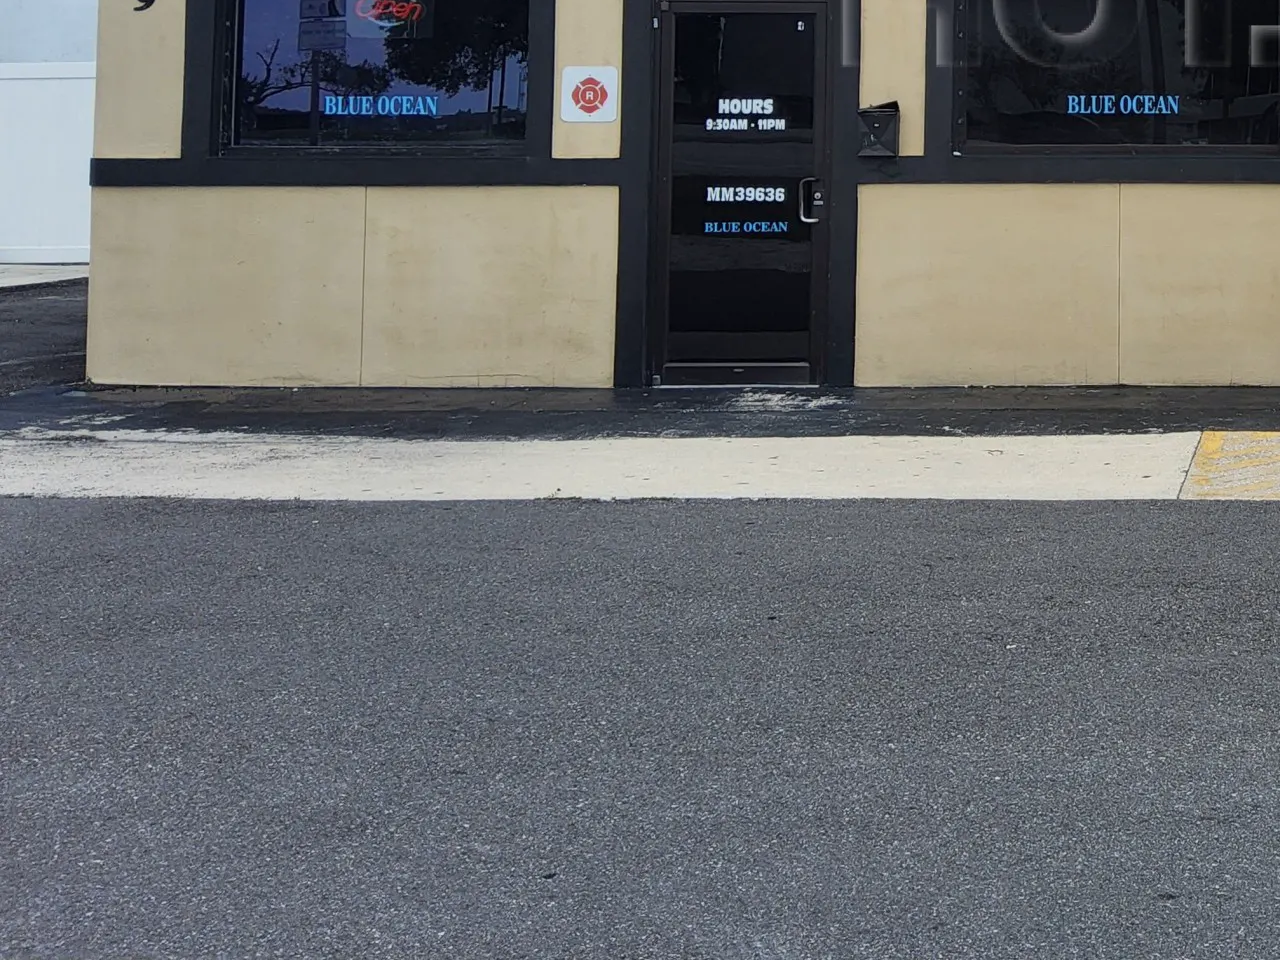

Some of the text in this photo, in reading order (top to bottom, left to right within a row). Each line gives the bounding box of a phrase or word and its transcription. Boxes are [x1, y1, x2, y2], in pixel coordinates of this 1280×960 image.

[585, 91, 594, 101] R
[324, 96, 438, 116] BLUE OCEAN
[718, 98, 774, 115] HOURS
[1067, 95, 1180, 115] BLUE OCEAN
[706, 118, 748, 131] 9:30AM
[757, 118, 786, 131] 11PM
[706, 187, 785, 202] MM39636
[704, 221, 789, 233] BLUE OCEAN
